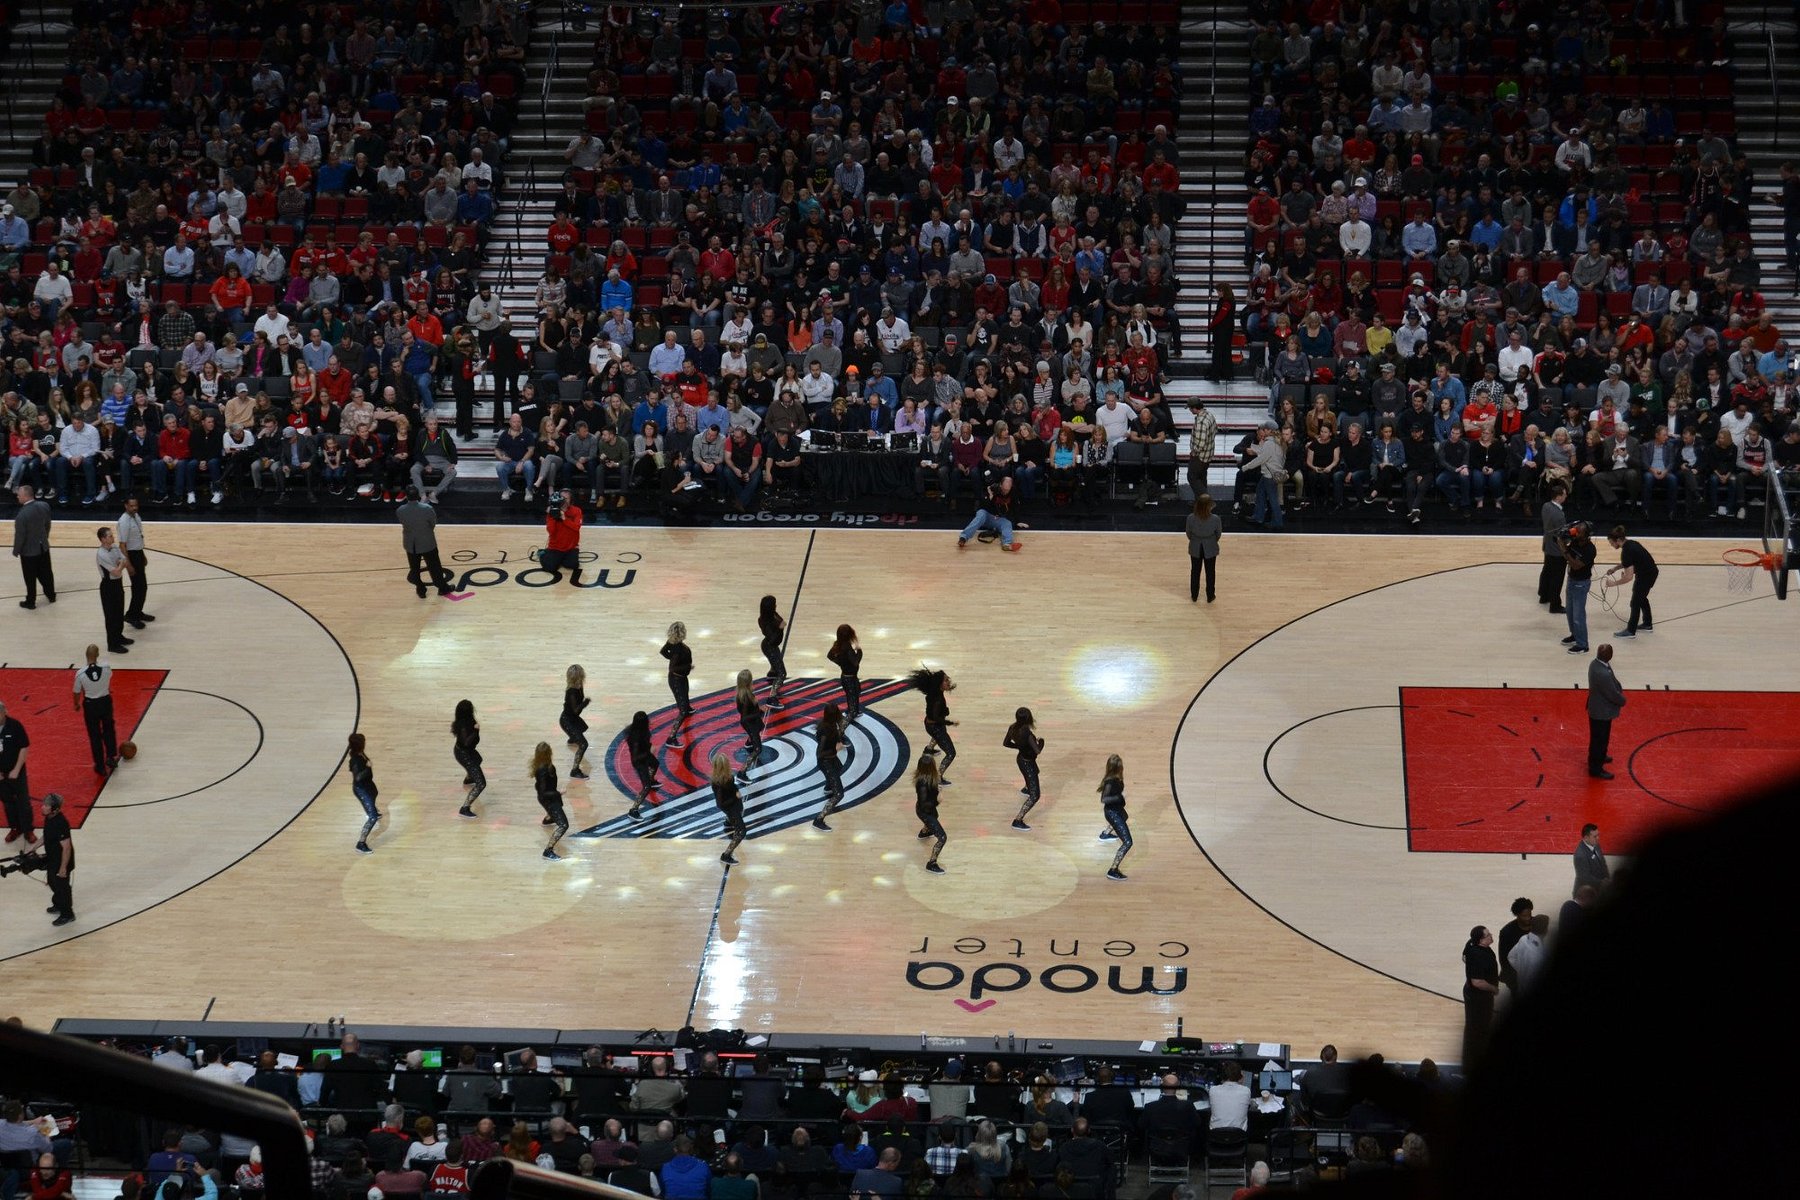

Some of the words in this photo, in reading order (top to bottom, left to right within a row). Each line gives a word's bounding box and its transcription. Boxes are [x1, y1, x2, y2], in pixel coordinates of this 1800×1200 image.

[723, 510, 821, 522] oregon
[419, 549, 642, 564] cete
[909, 936, 1190, 958] center
[905, 961, 1188, 1000] moda
